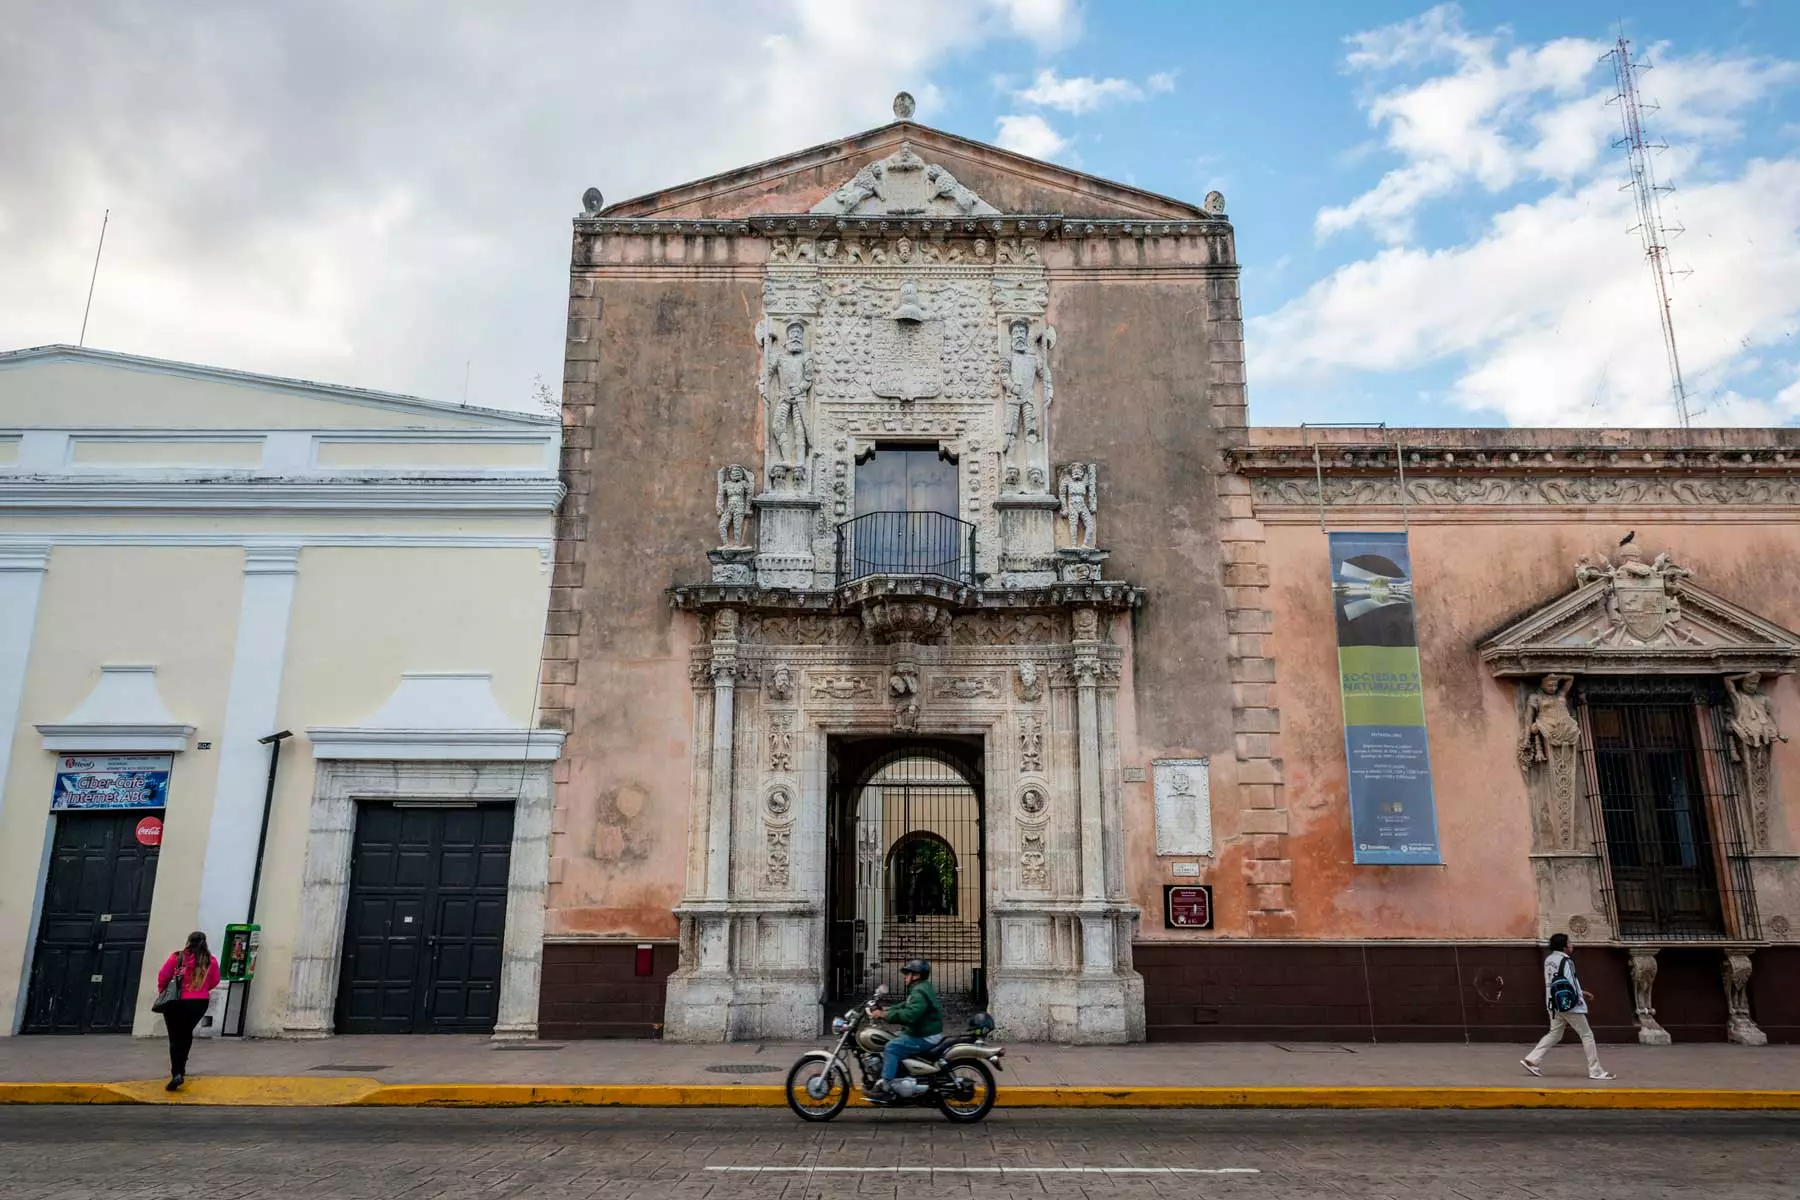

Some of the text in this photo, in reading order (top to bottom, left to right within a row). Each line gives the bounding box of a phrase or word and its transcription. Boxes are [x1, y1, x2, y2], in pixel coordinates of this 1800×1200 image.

[1343, 671, 1418, 681] SOCIEDAD Y
[1343, 682, 1420, 691] NATURALEZA
[67, 790, 151, 804] Internet ABC
